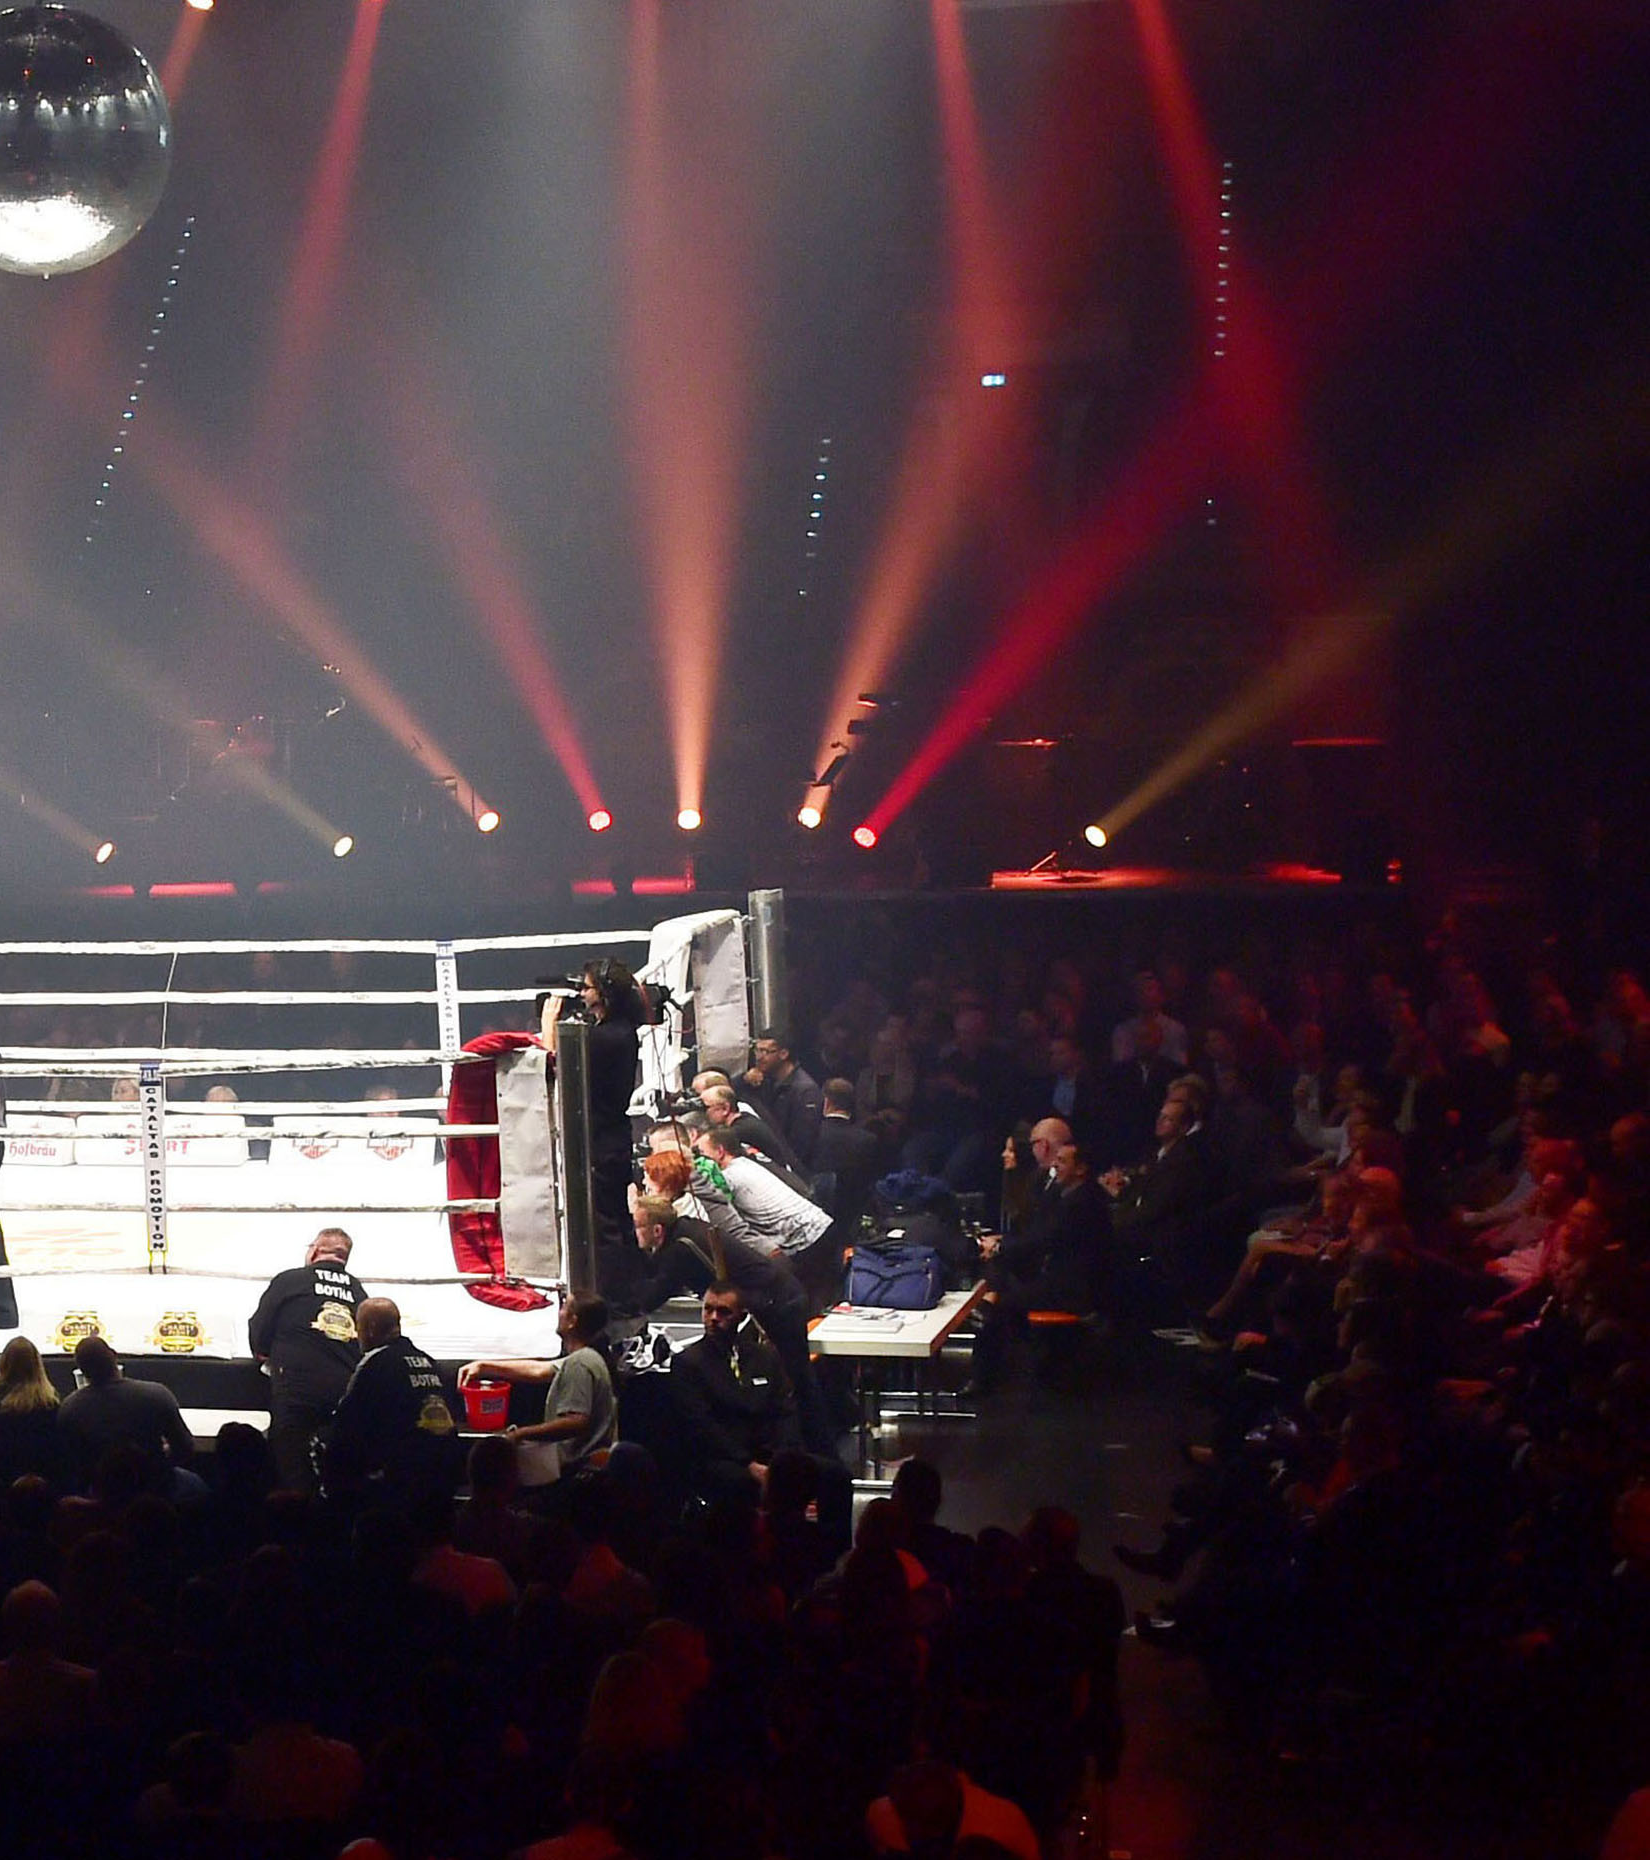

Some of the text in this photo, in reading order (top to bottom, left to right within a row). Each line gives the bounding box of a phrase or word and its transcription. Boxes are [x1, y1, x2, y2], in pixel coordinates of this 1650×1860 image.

[145, 1088, 158, 1158] CATALTAS
[150, 1170, 164, 1249] PROMOTION
[315, 1269, 350, 1285] TEAM
[315, 1283, 355, 1303] BOTHA
[404, 1356, 432, 1368] TEAM
